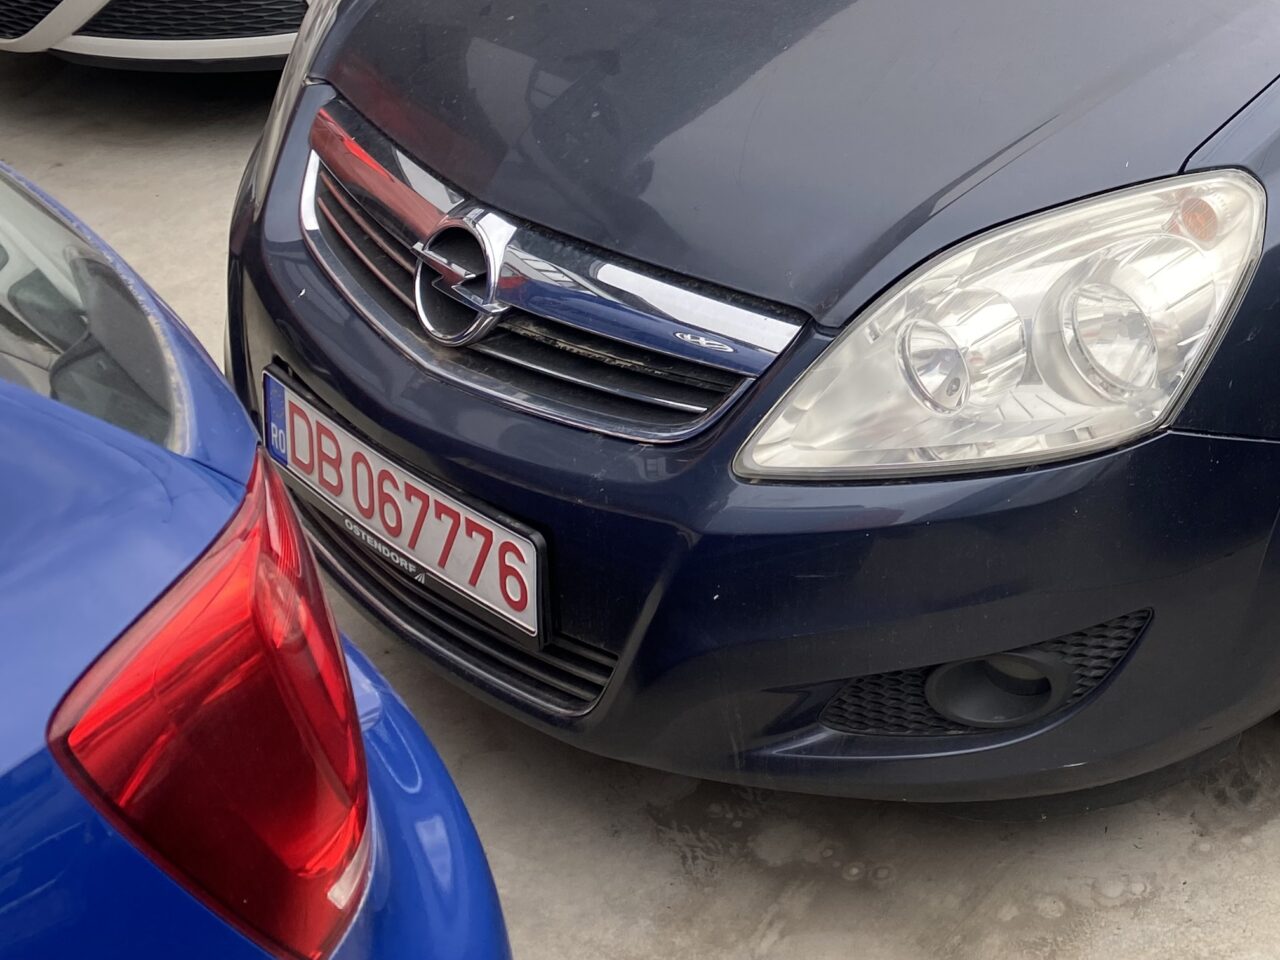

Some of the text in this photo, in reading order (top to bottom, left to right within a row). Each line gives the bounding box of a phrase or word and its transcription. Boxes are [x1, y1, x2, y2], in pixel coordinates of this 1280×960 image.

[271, 422, 286, 454] RO
[288, 400, 528, 614] DB 067776
[344, 518, 417, 574] OSTENDORF
